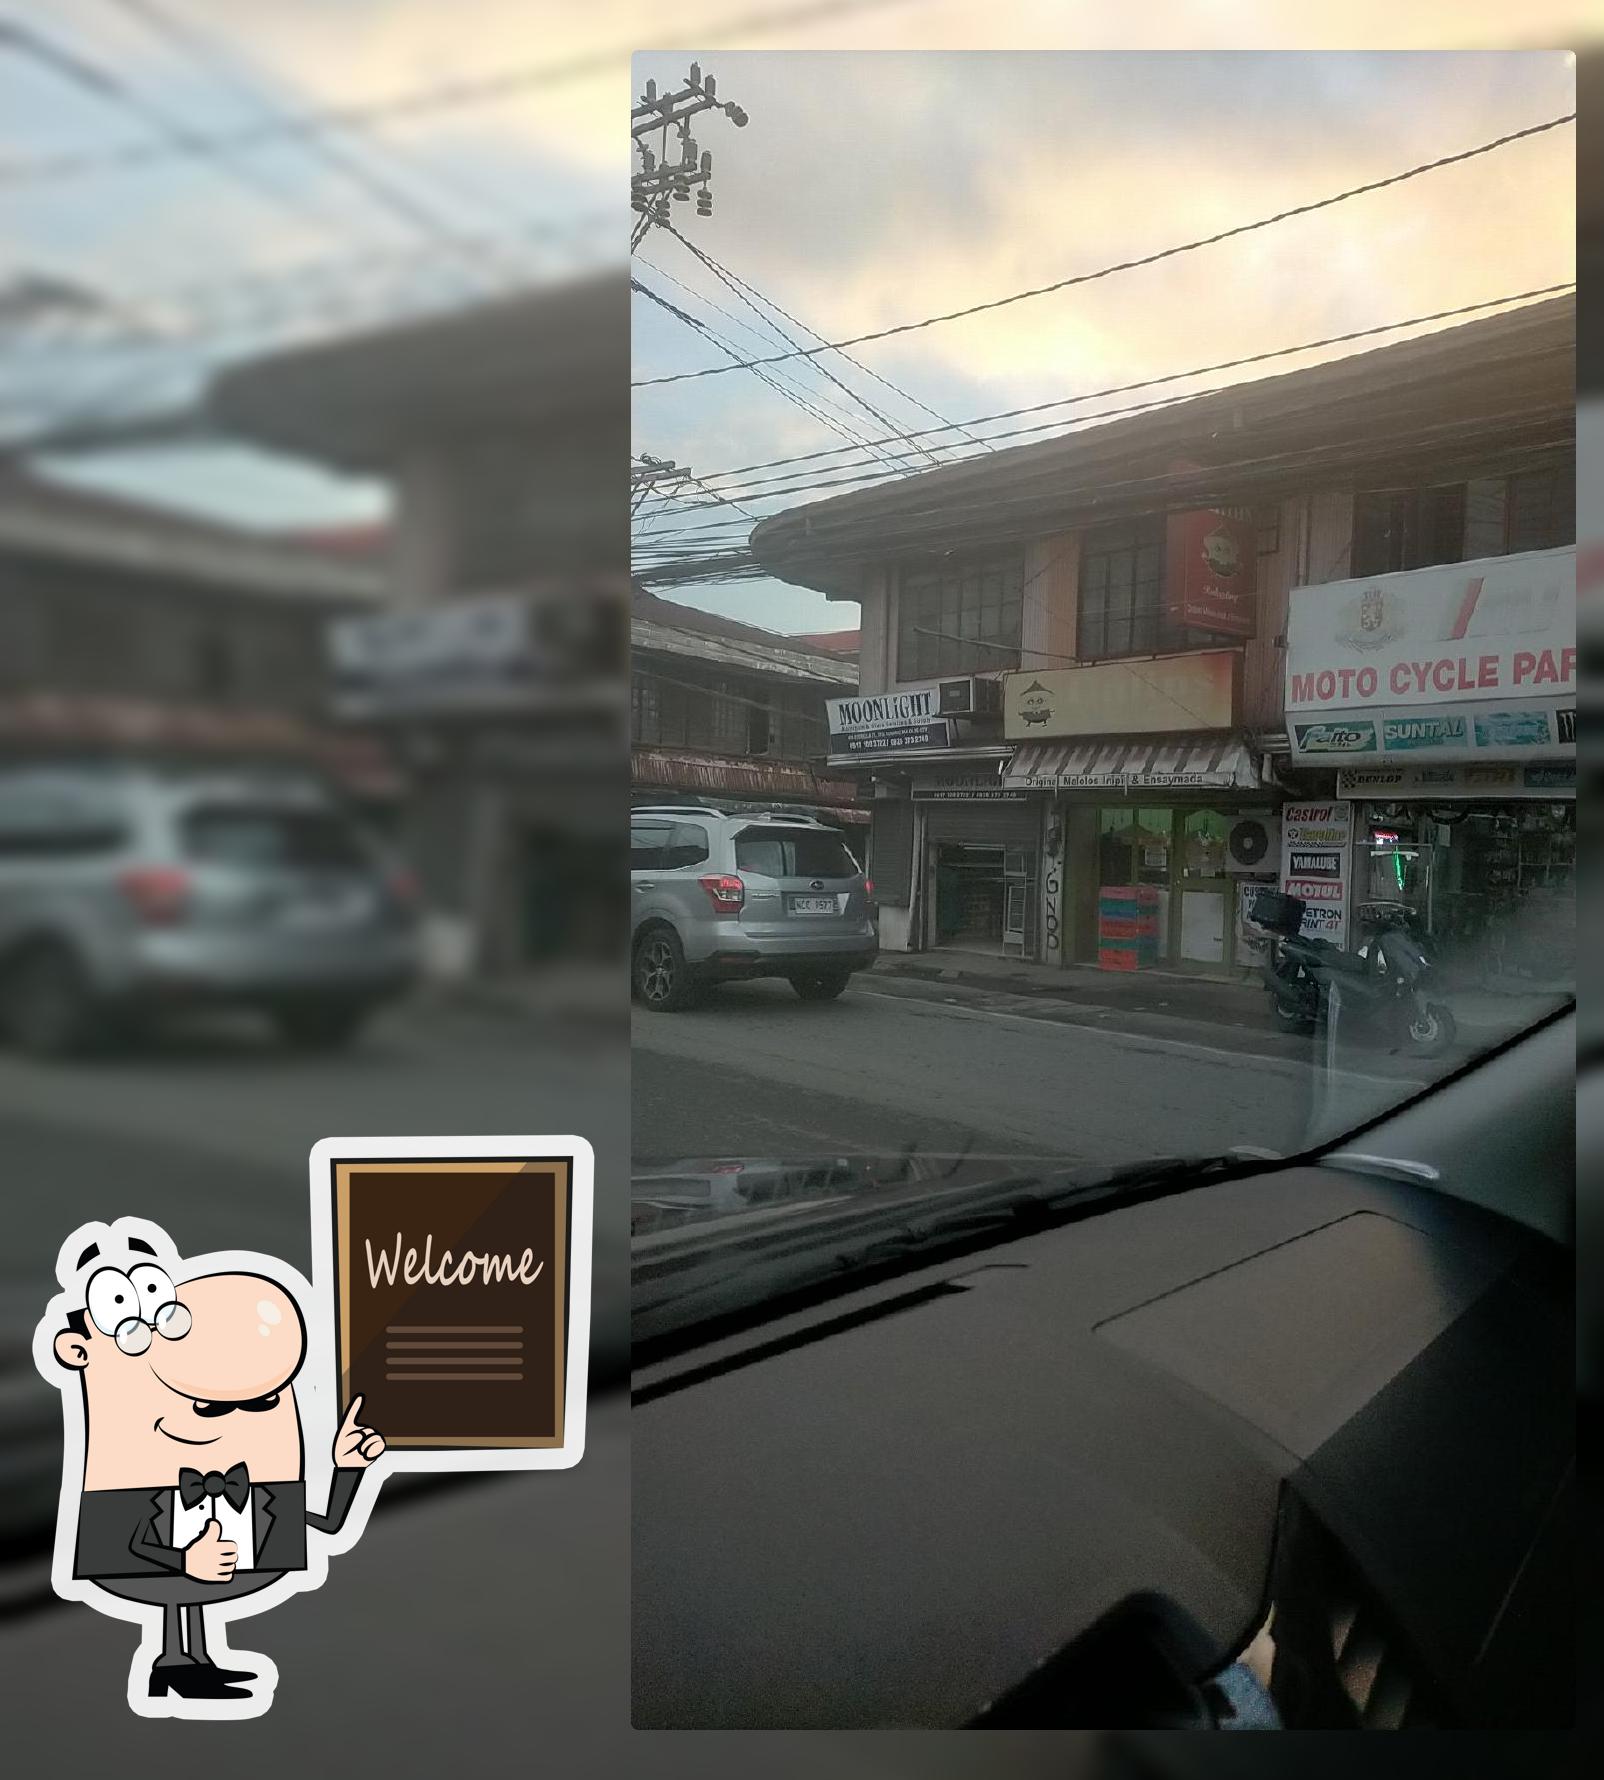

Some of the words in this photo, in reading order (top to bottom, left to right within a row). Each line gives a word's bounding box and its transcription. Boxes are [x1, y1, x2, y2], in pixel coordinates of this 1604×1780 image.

[1291, 666, 1378, 703] MOTO
[1389, 655, 1499, 695] CYCLE
[1025, 776, 1056, 787] Origina
[1102, 775, 1125, 788] Inipi
[1132, 776, 1140, 788] &
[1144, 774, 1203, 789] Ensaymada
[1286, 807, 1333, 822] Castrol
[1293, 856, 1337, 871] YAMALUBE
[1288, 883, 1341, 898] MOTUL
[1305, 908, 1342, 919] ETRON
